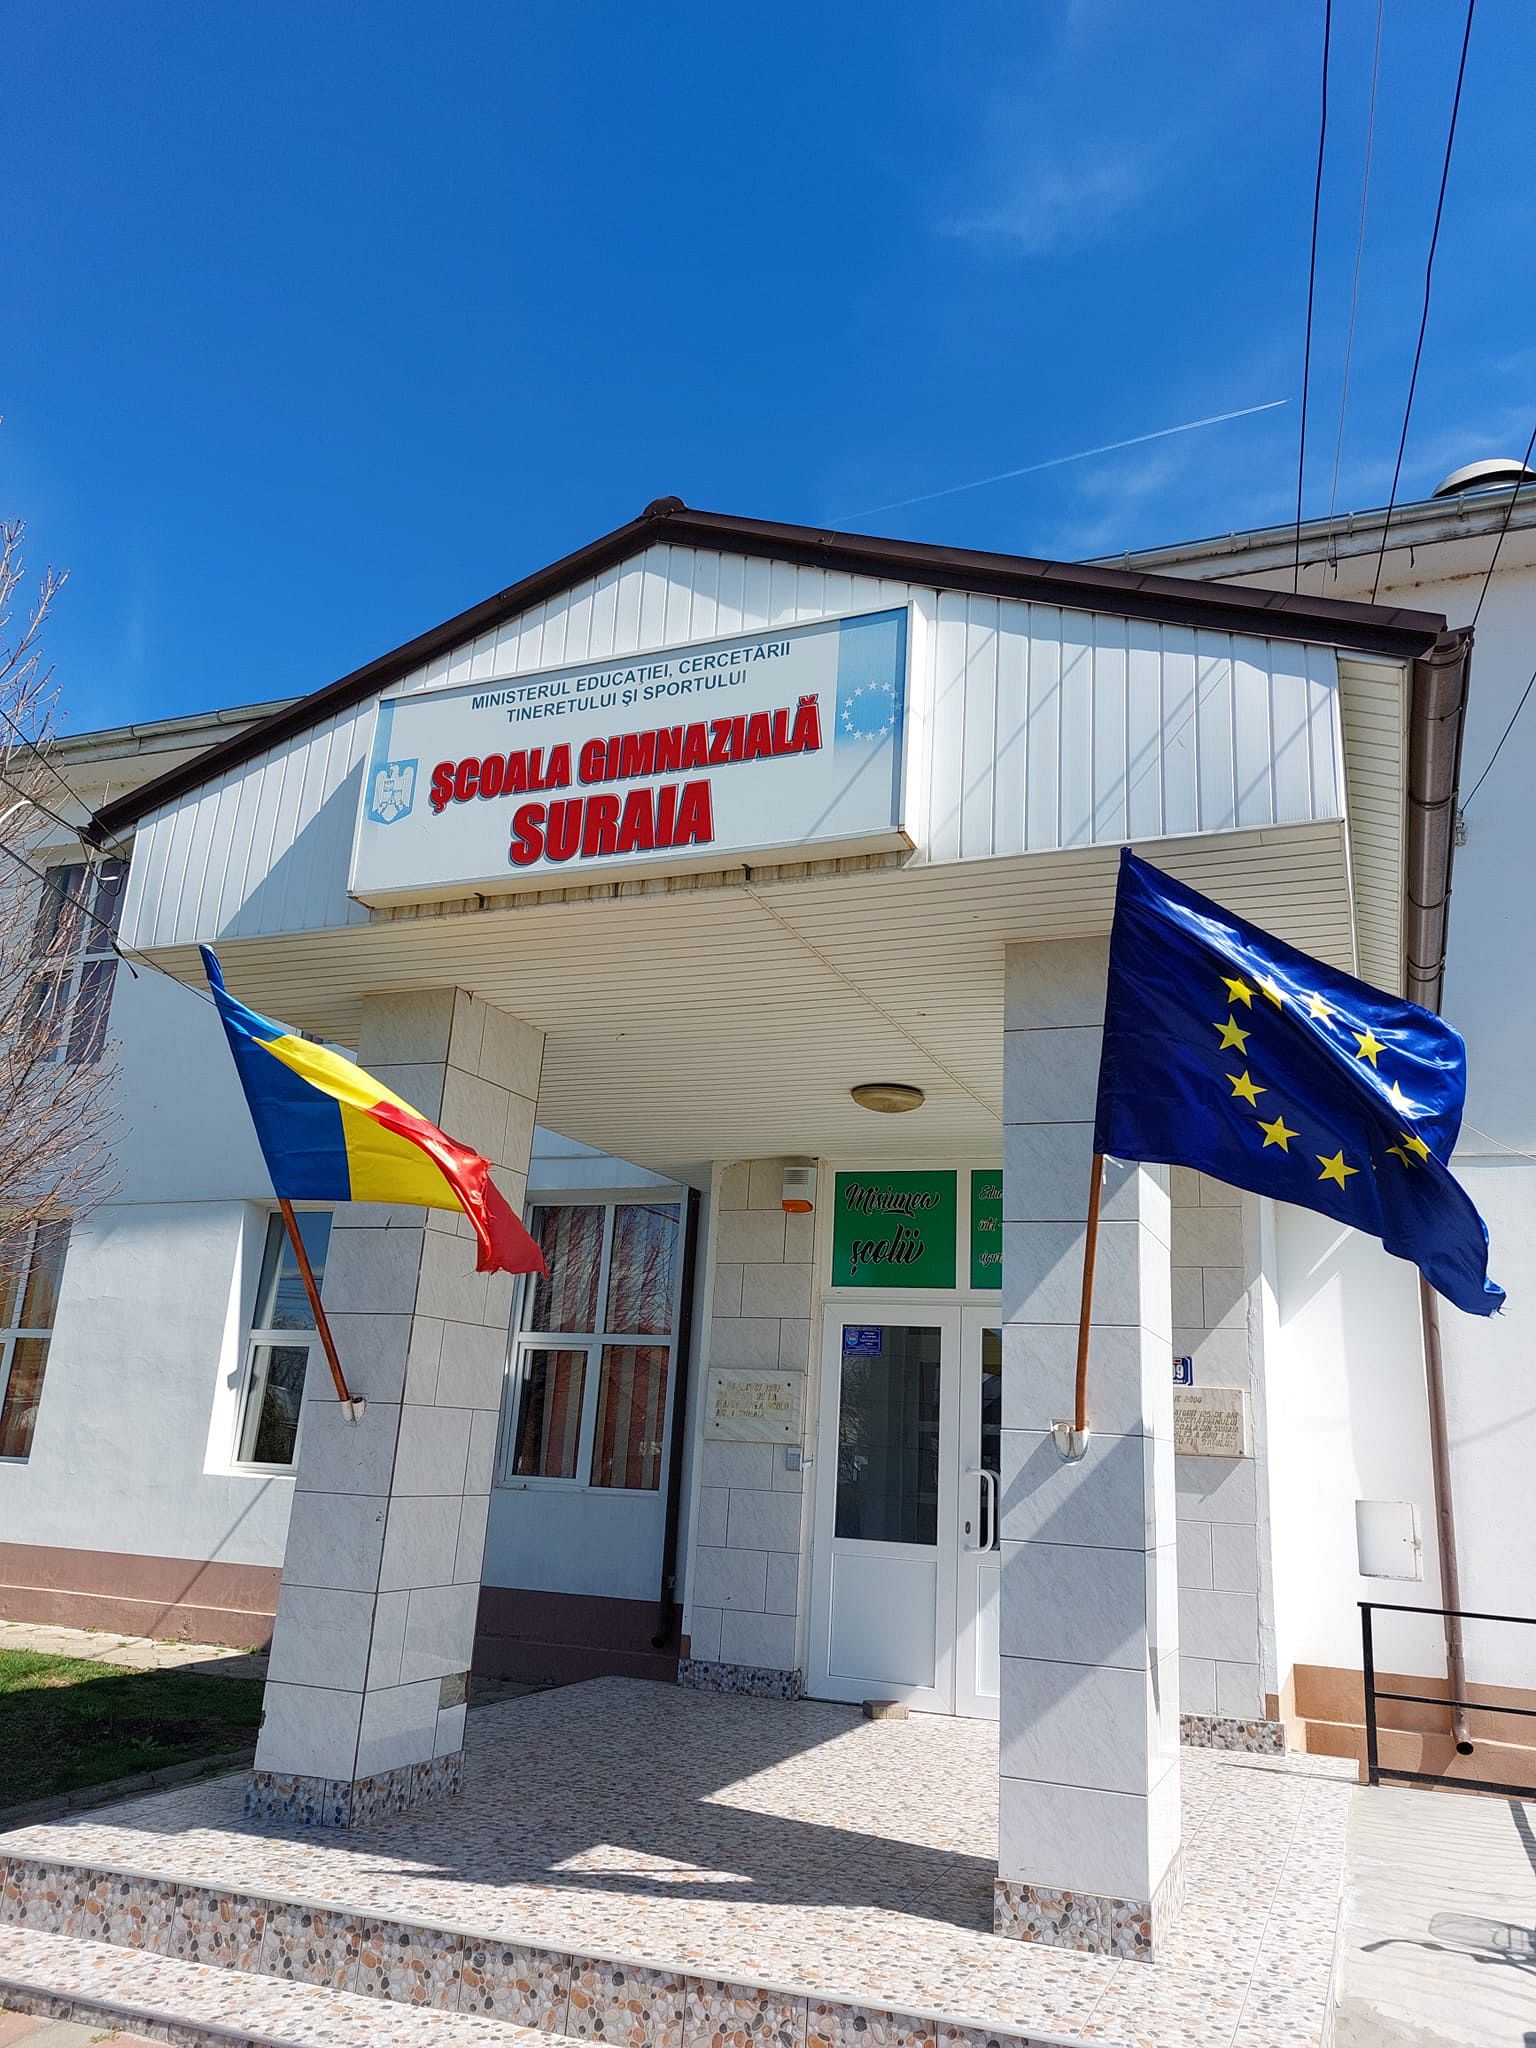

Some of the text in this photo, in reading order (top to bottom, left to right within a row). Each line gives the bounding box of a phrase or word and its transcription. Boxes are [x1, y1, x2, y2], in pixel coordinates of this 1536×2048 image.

[471, 681, 570, 710] MINISTERUL
[679, 641, 790, 674] CERCETĂRII
[506, 692, 616, 722] TINERETULUI
[643, 670, 747, 699] SPORTULUI
[430, 694, 823, 815] ŞCOALA GIMNAZIALĂ
[508, 779, 715, 866] SURAIA
[845, 1182, 941, 1219] Misiunea
